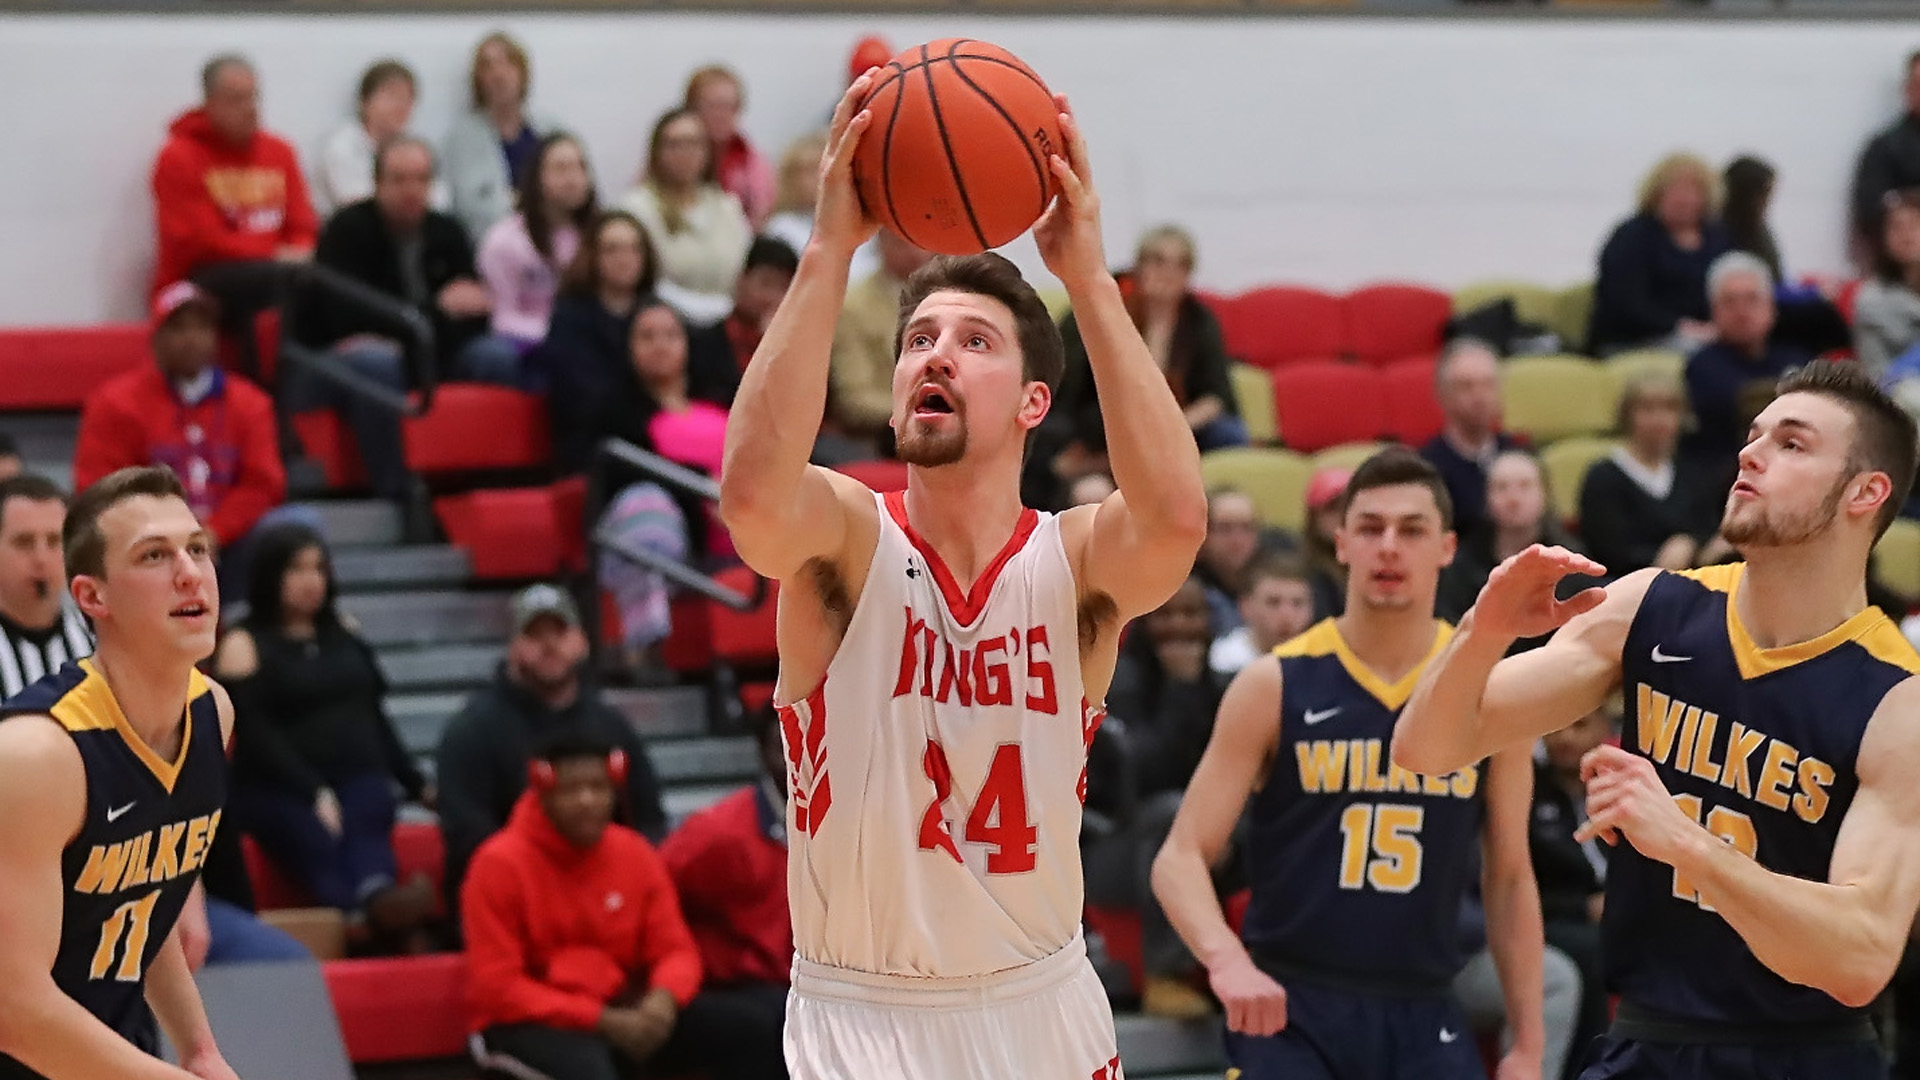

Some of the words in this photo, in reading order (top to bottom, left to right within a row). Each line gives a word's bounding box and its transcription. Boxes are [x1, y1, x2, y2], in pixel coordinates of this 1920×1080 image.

[1637, 681, 1837, 825] WILKES
[73, 807, 222, 894] WILKES
[917, 738, 1038, 877] 24
[1339, 802, 1425, 893] 15
[88, 889, 163, 982] 11
